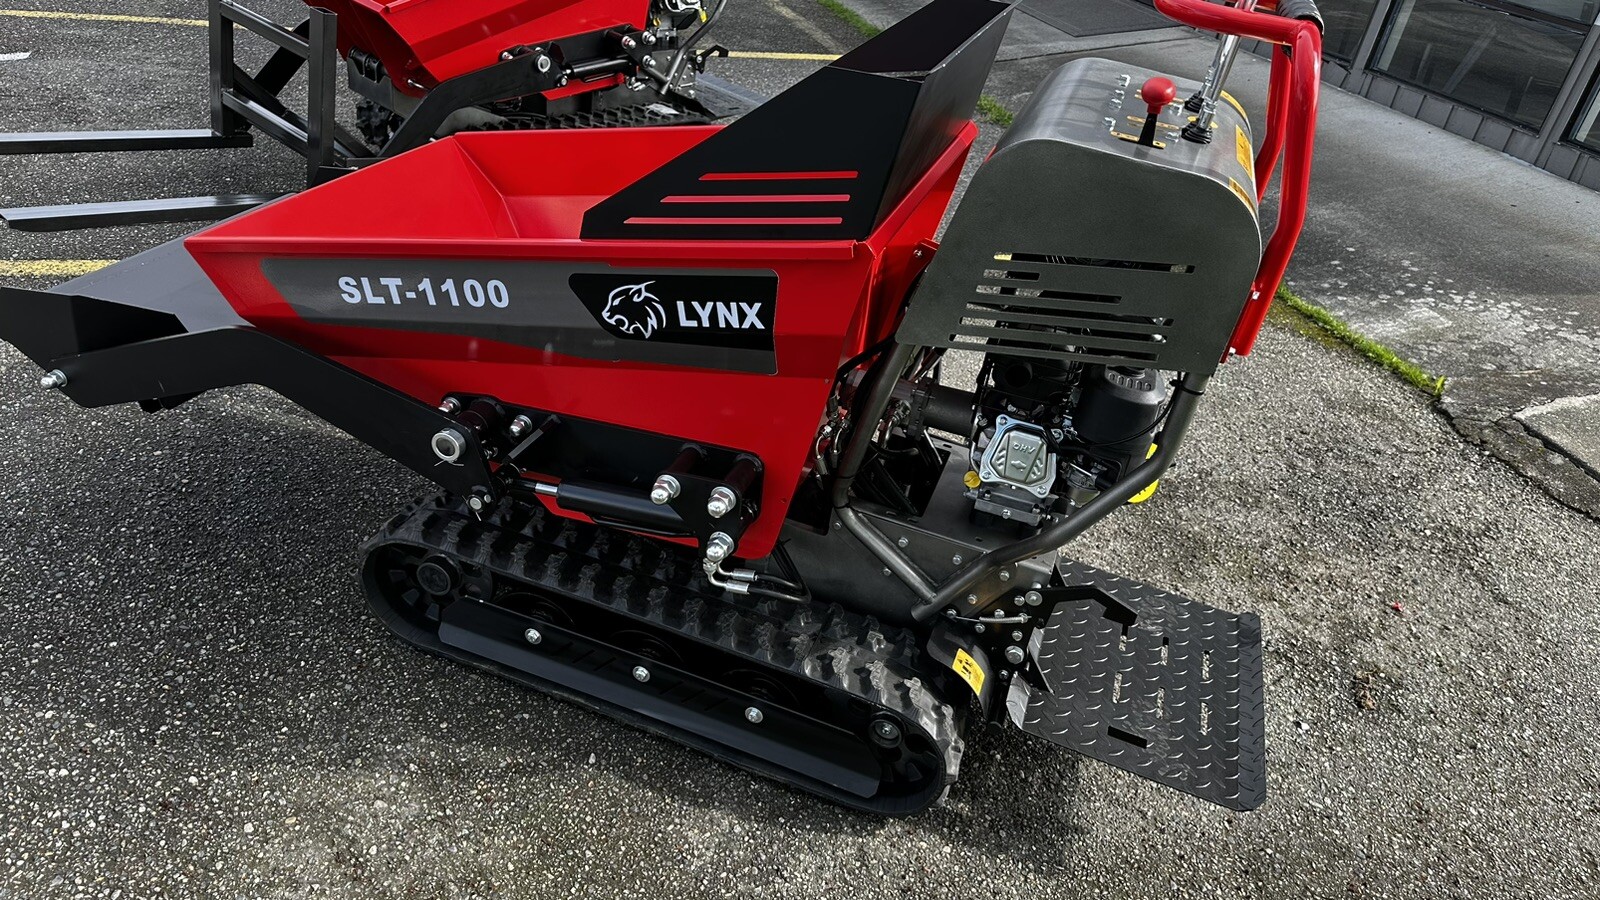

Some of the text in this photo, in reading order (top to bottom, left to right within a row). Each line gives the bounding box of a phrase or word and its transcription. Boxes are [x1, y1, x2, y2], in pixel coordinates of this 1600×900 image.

[338, 276, 509, 308] SLT-1100
[677, 301, 765, 329] LYNX
[1013, 442, 1035, 454] OHV
